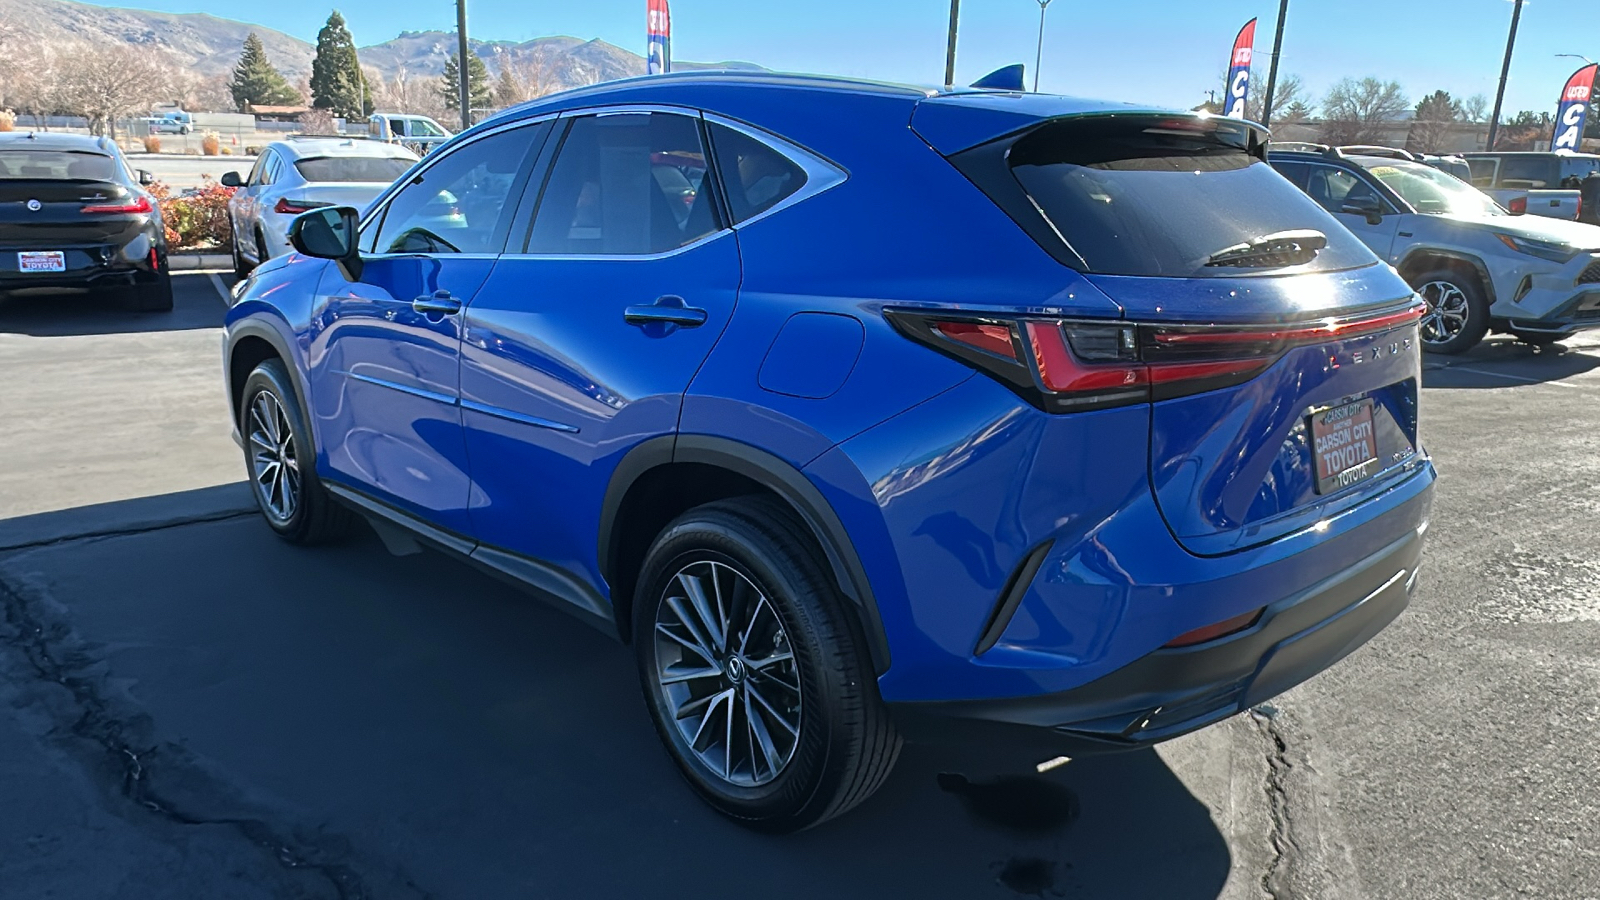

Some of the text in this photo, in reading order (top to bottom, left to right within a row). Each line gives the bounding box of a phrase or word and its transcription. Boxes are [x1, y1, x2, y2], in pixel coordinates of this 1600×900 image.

[1567, 86, 1588, 98] USED
[1329, 339, 1412, 368] LEXUS
[1327, 403, 1361, 422] CARSON CITY
[1316, 420, 1372, 453] CARSON CITY
[1324, 440, 1370, 474] TOYOTA
[1337, 465, 1367, 487] TOYOTA
